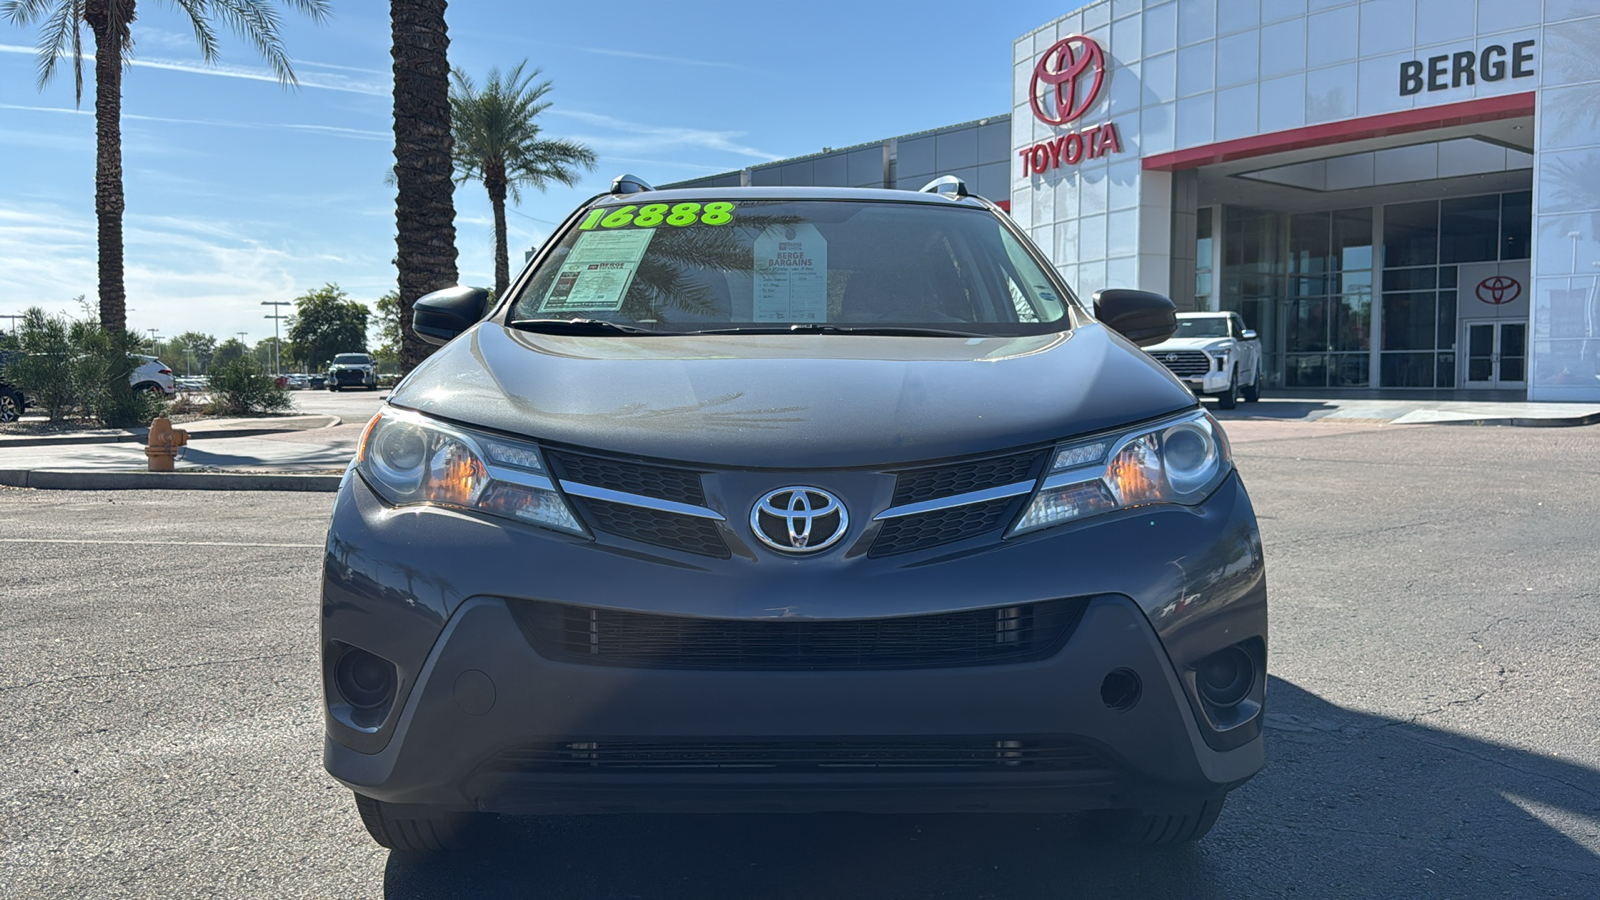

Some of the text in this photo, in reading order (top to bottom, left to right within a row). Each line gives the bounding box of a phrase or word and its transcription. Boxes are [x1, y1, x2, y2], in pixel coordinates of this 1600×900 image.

[1400, 40, 1535, 96] BERGE
[1019, 121, 1119, 177] TOYOTA
[578, 202, 735, 230] 16888
